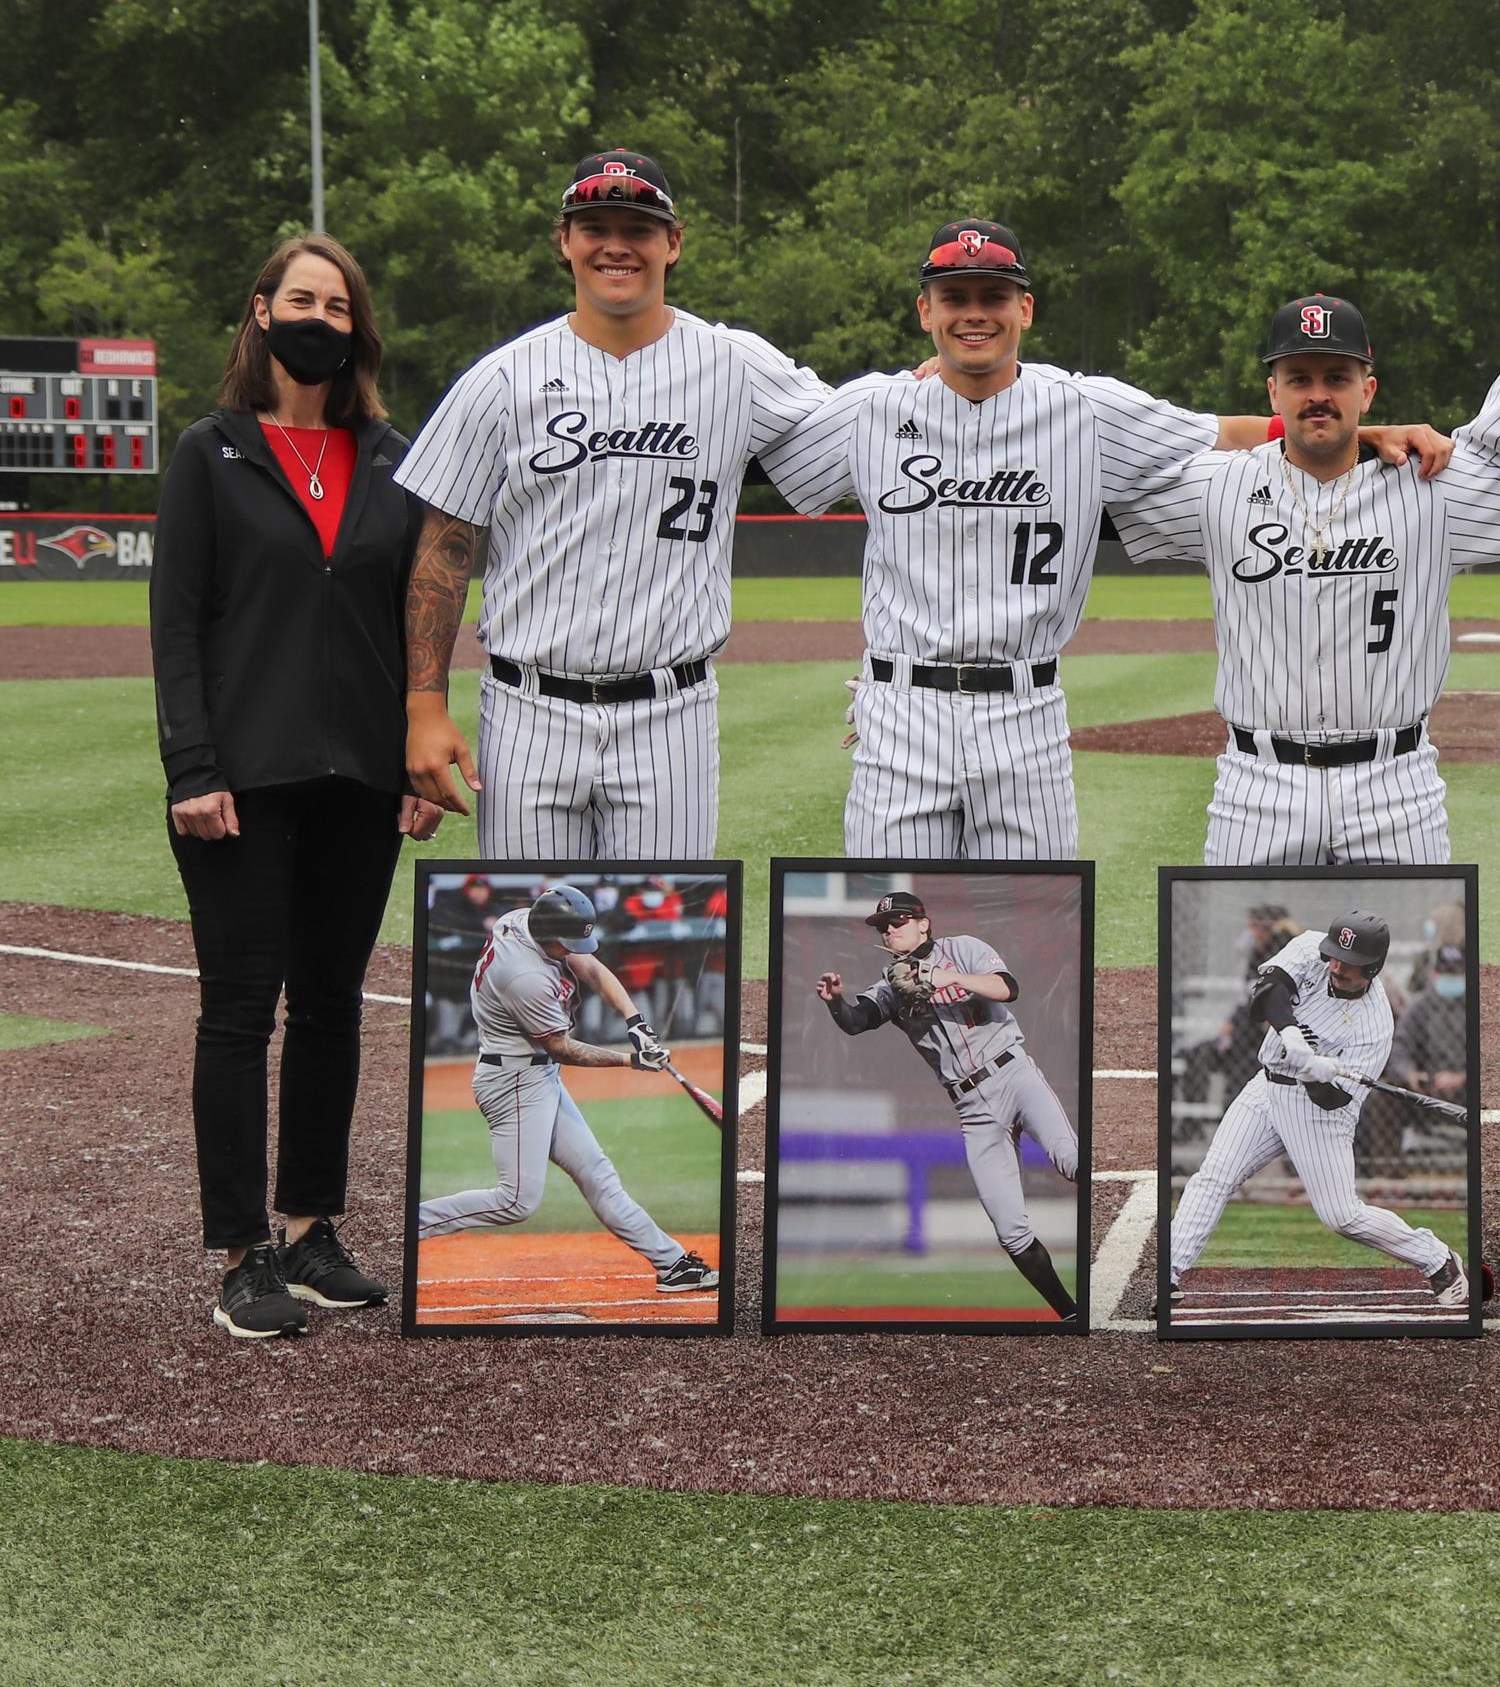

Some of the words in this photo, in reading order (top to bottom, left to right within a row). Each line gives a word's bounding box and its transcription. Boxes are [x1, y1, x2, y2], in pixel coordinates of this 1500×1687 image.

[528, 411, 700, 475] Seattle
[656, 476, 718, 542] 23
[878, 454, 1051, 515] Seattle
[117, 531, 155, 567] BA
[1010, 522, 1063, 585] 12
[1232, 523, 1399, 583] Seattle
[1367, 589, 1399, 654] 5
